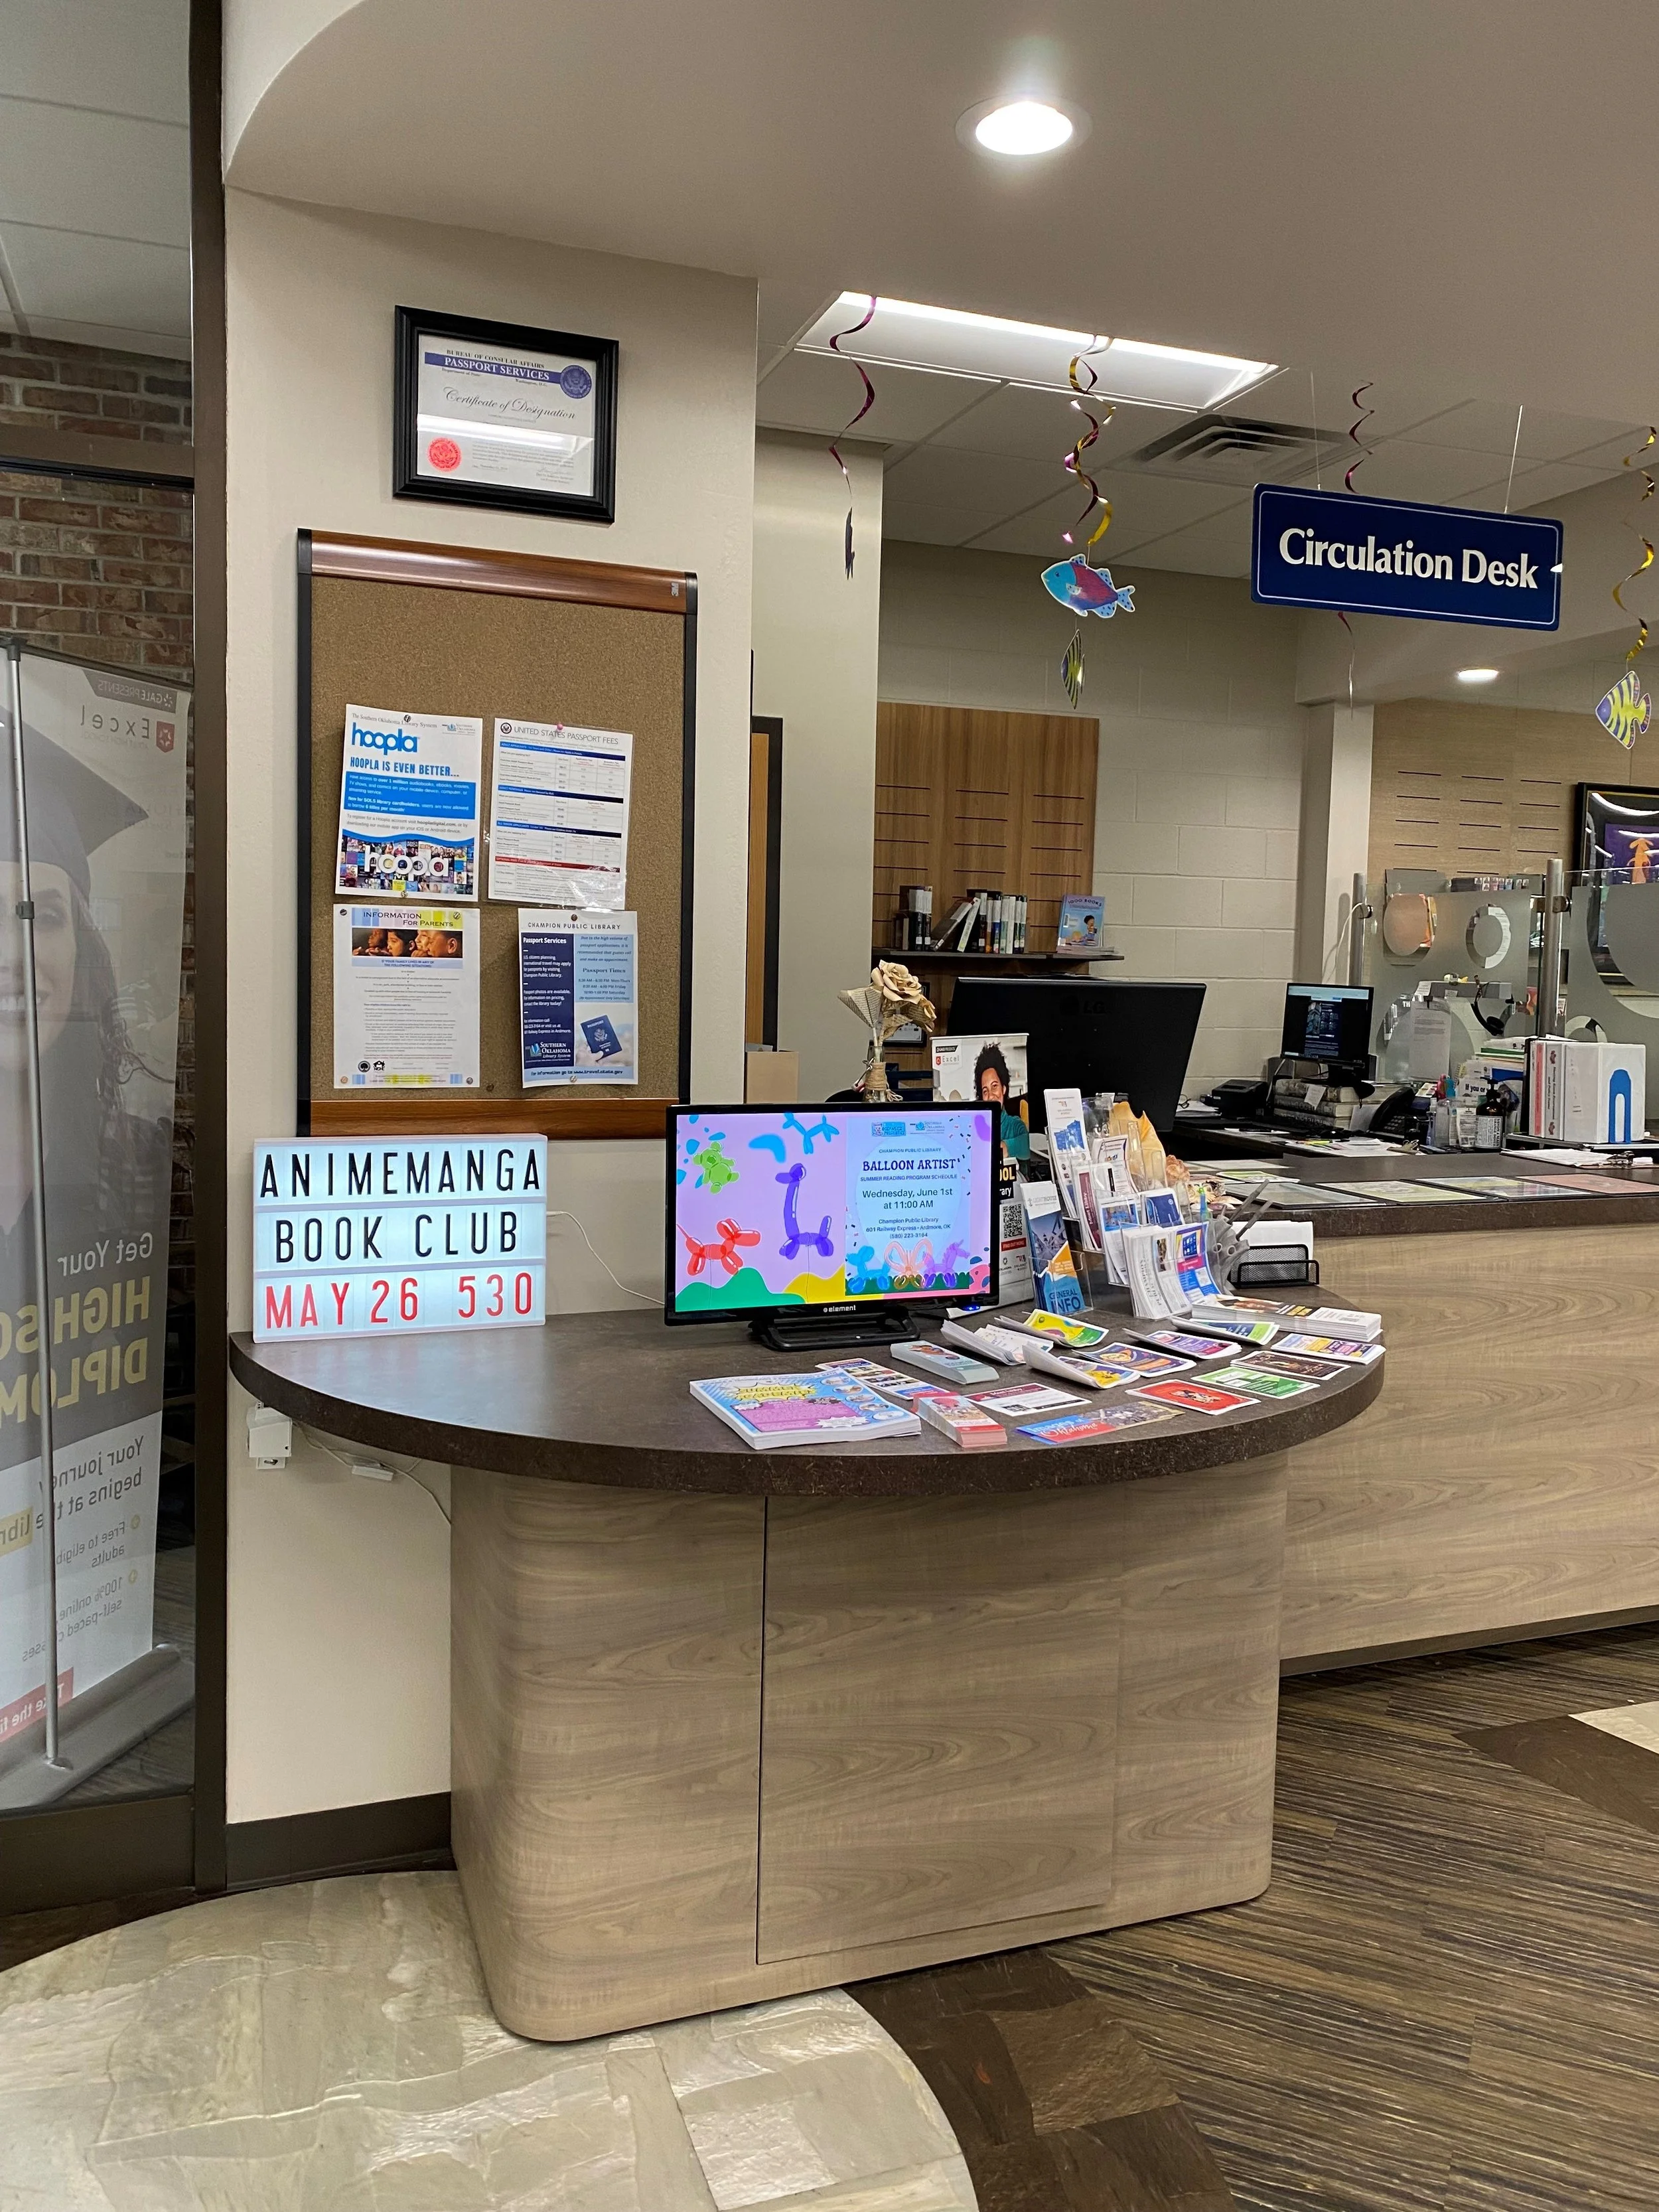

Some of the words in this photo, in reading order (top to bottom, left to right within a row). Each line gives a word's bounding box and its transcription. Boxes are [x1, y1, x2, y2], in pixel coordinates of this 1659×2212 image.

[445, 357, 498, 372] PASSPORT
[500, 366, 549, 380] SERVICES
[485, 355, 517, 364] CONSULAR
[443, 387, 497, 409] Certificate
[500, 400, 510, 412] of
[512, 398, 575, 420] Designation
[1279, 527, 1453, 581] Circulation
[1461, 548, 1539, 589] Desk
[352, 722, 417, 755] hoopla
[514, 727, 539, 735] UNITED
[541, 729, 565, 738] STATES
[567, 733, 601, 743] PASSPORT
[350, 757, 379, 771] HOOPLA
[382, 761, 390, 771] IS
[394, 763, 415, 774] EVEN
[419, 765, 459, 777] BETTER...
[364, 844, 449, 881] hoopla
[863, 1160, 914, 1171] BALLOON
[918, 1159, 956, 1169] ARTIST
[863, 1189, 914, 1198] Wednesday,
[275, 1215, 383, 1263] BOOK
[415, 1211, 517, 1258] CLUB
[265, 1282, 350, 1329] MAY
[370, 1278, 418, 1323] 26
[458, 1272, 532, 1319] 530
[1049, 1288, 1078, 1299] GENERAL
[1050, 1296, 1080, 1313] INFO
[1027, 1420, 1075, 1432] Images
[1040, 1423, 1098, 1437] Oklahoma
